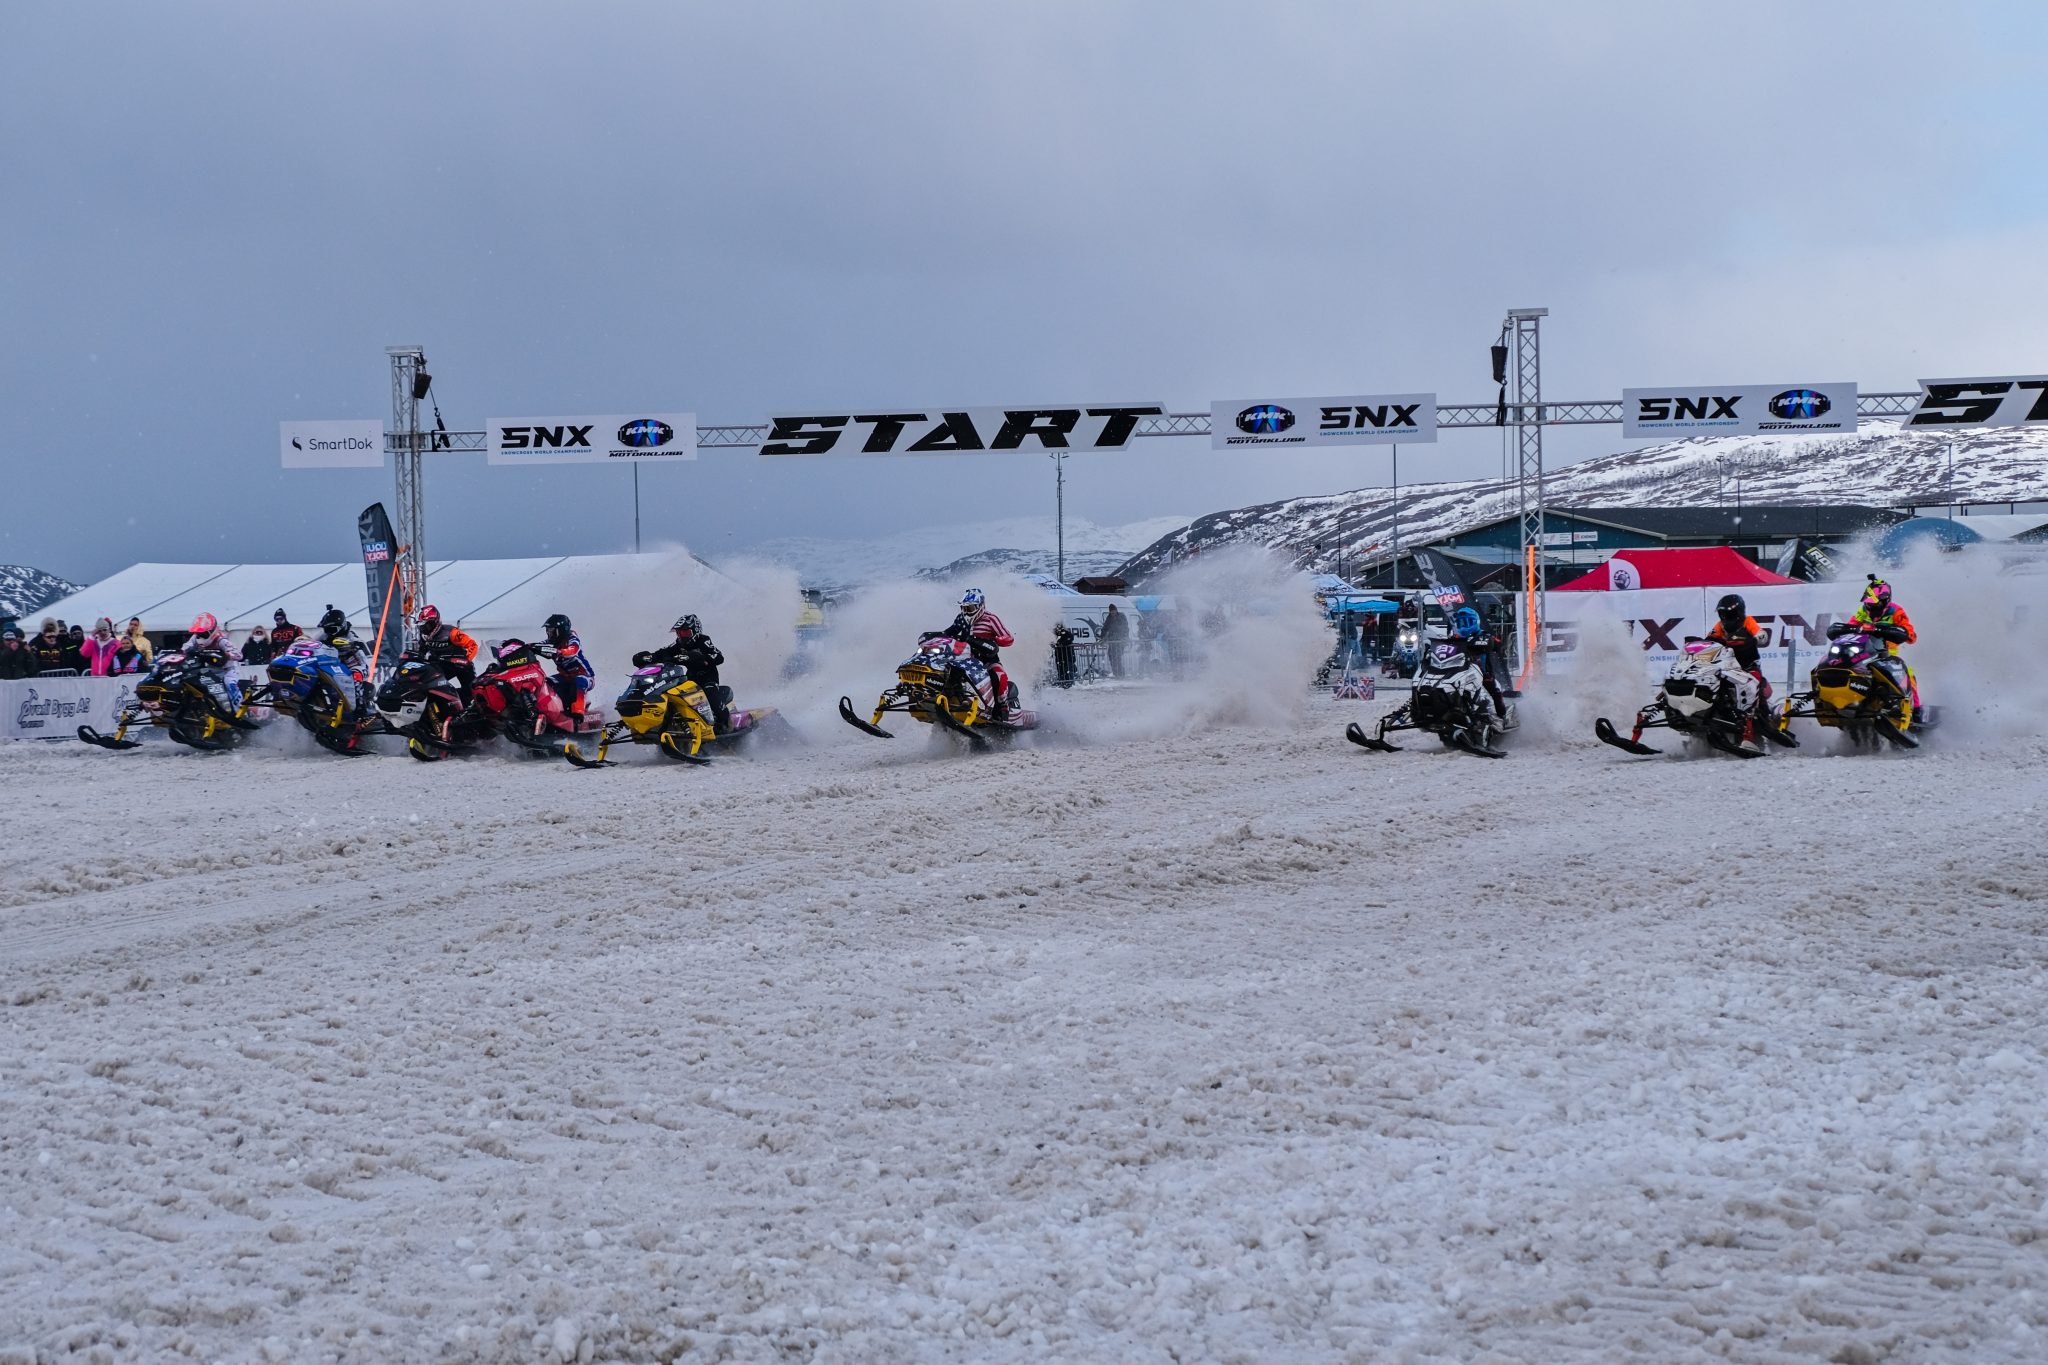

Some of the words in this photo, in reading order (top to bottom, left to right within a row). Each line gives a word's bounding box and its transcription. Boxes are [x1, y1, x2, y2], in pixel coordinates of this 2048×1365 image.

[1778, 397, 1821, 407] KMK
[1638, 396, 1743, 421] SNX
[1245, 412, 1286, 421] KMK
[1320, 404, 1421, 429] SNX
[626, 427, 664, 435] KMK
[759, 406, 1163, 455] START
[501, 425, 594, 449] SNX
[309, 438, 373, 450] SmartDok
[1436, 643, 1456, 654] 237
[511, 673, 539, 683] POLARIS
